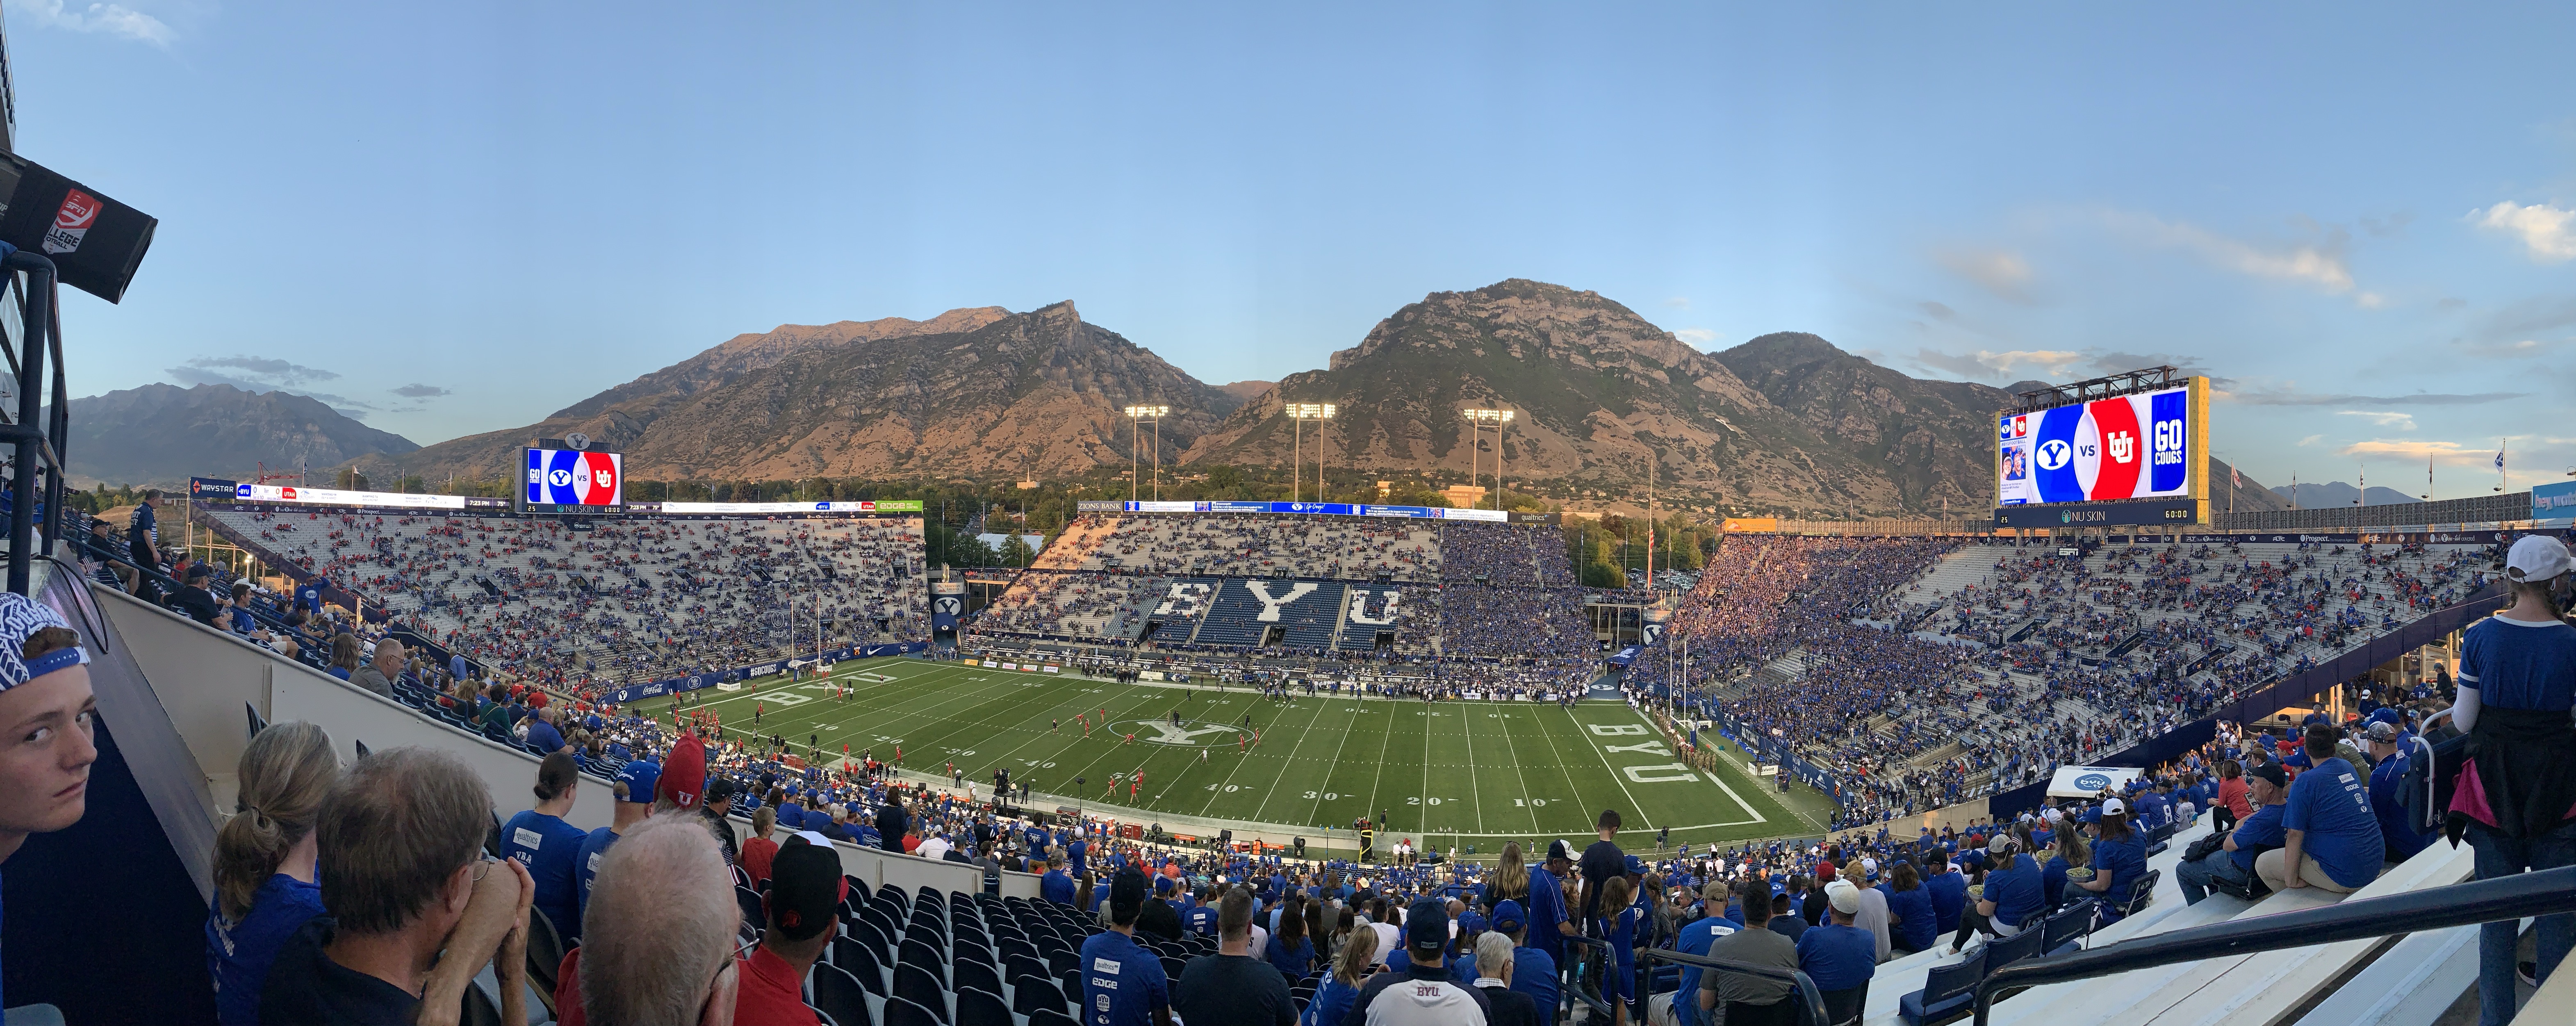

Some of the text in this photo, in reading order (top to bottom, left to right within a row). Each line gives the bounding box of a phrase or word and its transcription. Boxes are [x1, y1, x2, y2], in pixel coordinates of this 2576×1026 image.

[2155, 419, 2182, 451] GO
[2080, 445, 2095, 457] VS
[2155, 450, 2182, 465] COUGS
[530, 469, 540, 479] GO
[201, 484, 234, 493] WAYSTAR
[1306, 503, 1325, 513] Go Cougs!
[2071, 511, 2105, 522] NU SKIN
[2059, 548, 2079, 556] ESPN
[769, 629, 788, 639] Allstate
[750, 663, 777, 677] #GOCOUGS
[643, 684, 663, 696] Coca-Cola
[1587, 723, 1700, 783] BYU
[1792, 756, 1798, 764] NU
[1792, 764, 1801, 775] SKIN
[1204, 783, 1239, 792] 40
[1836, 785, 1840, 797] 25
[1303, 790, 1338, 800] 30
[1407, 797, 1442, 805] 20
[1514, 798, 1546, 807] 10
[2163, 805, 2173, 824] 8
[2136, 819, 2147, 833] 1
[517, 832, 538, 845] qualtrics
[1096, 962, 1114, 971] qualtrics
[1417, 987, 1441, 996] BYU.
